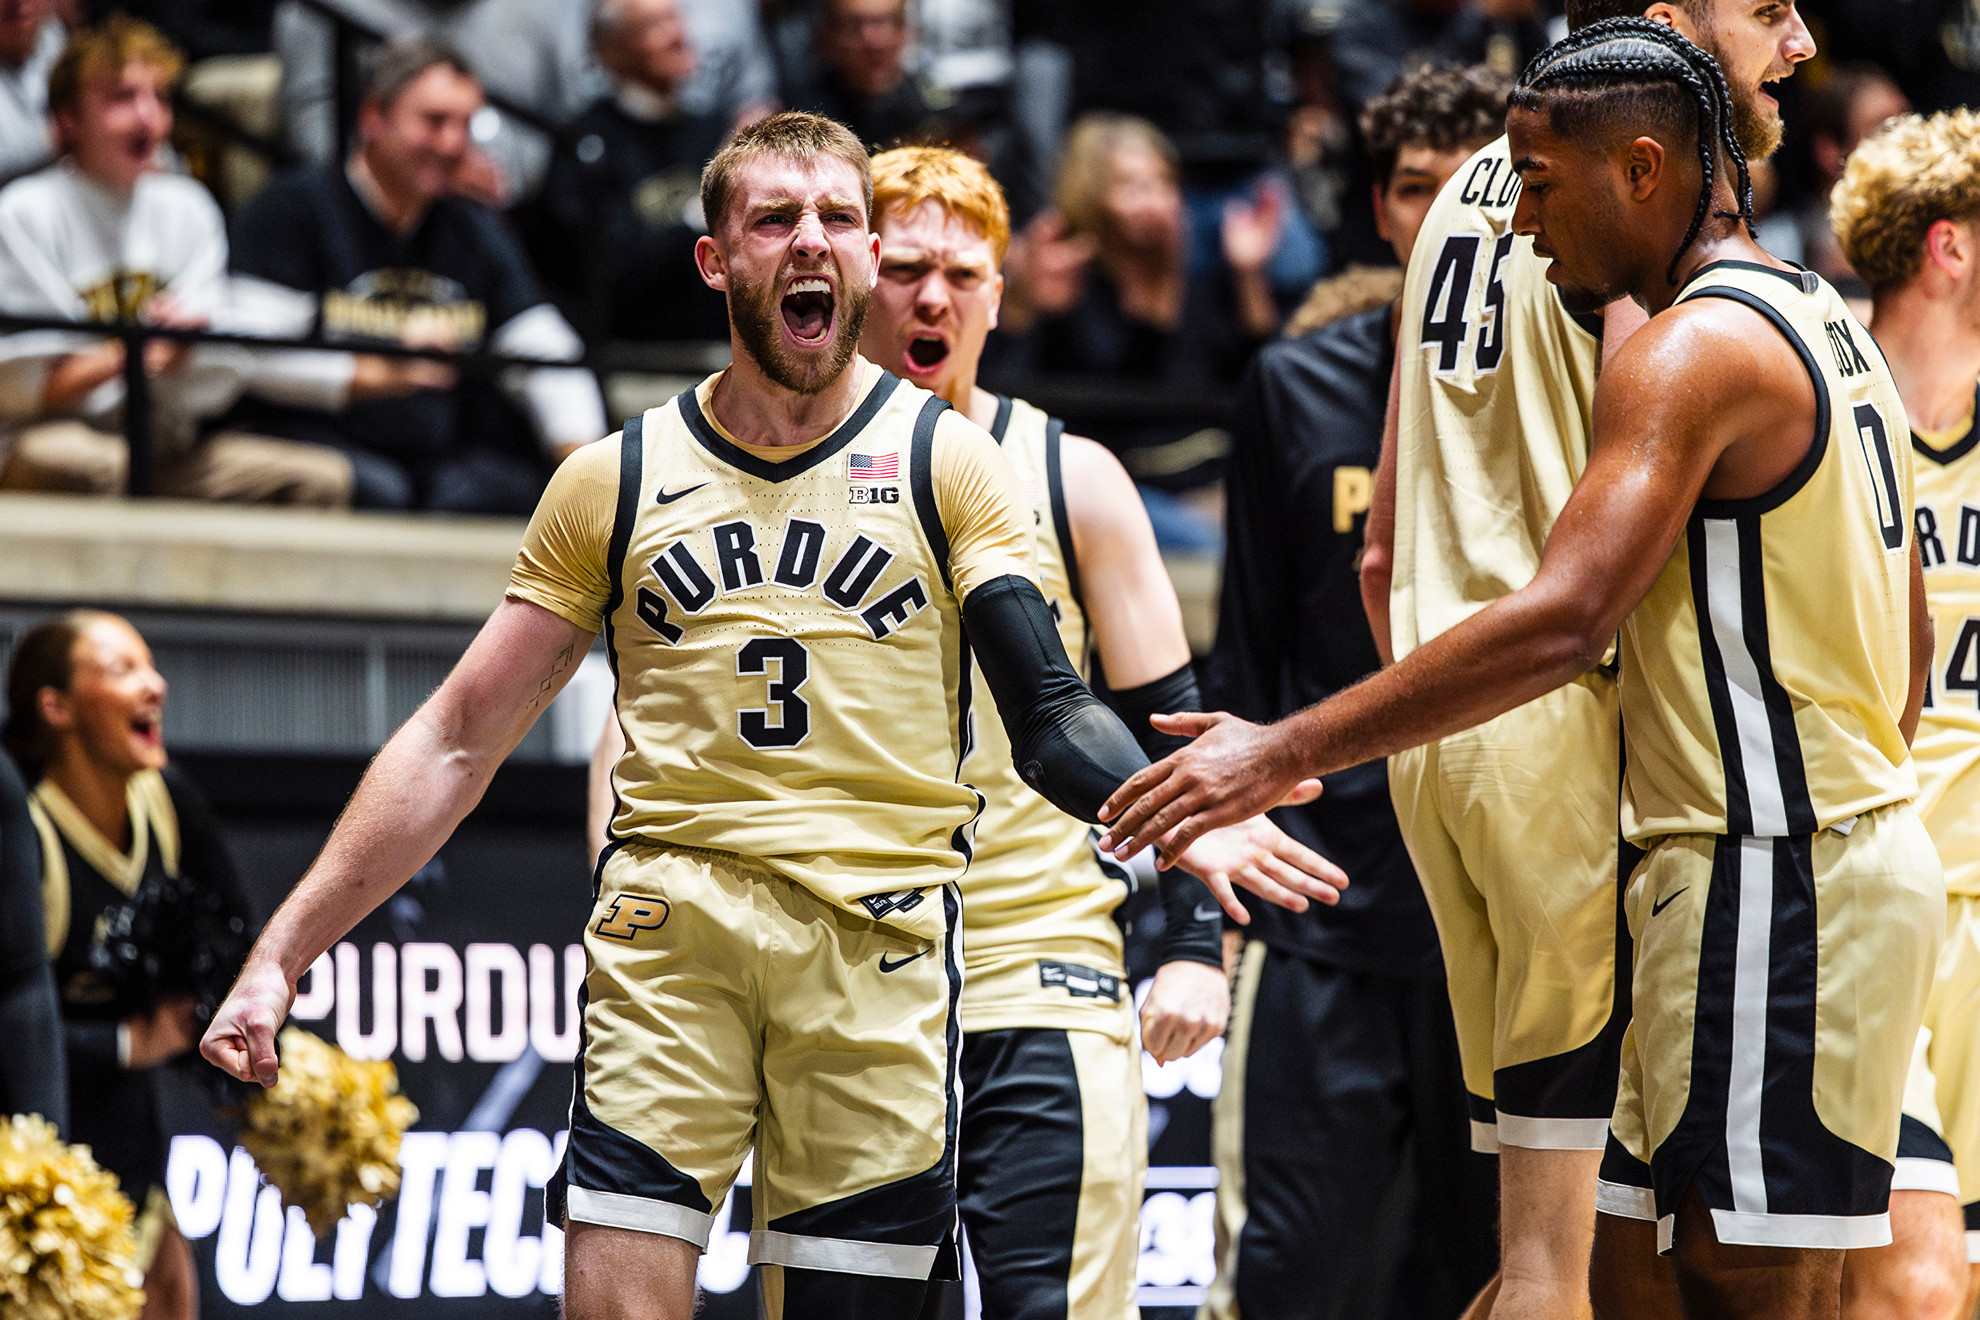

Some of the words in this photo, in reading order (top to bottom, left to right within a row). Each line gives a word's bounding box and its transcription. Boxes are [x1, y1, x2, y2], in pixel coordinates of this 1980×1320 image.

[1419, 232, 1514, 375] 45
[1850, 399, 1904, 556] 0
[634, 517, 930, 646] PURDUE
[735, 637, 811, 751] 3
[1922, 614, 1980, 712] 4
[592, 891, 672, 941] P
